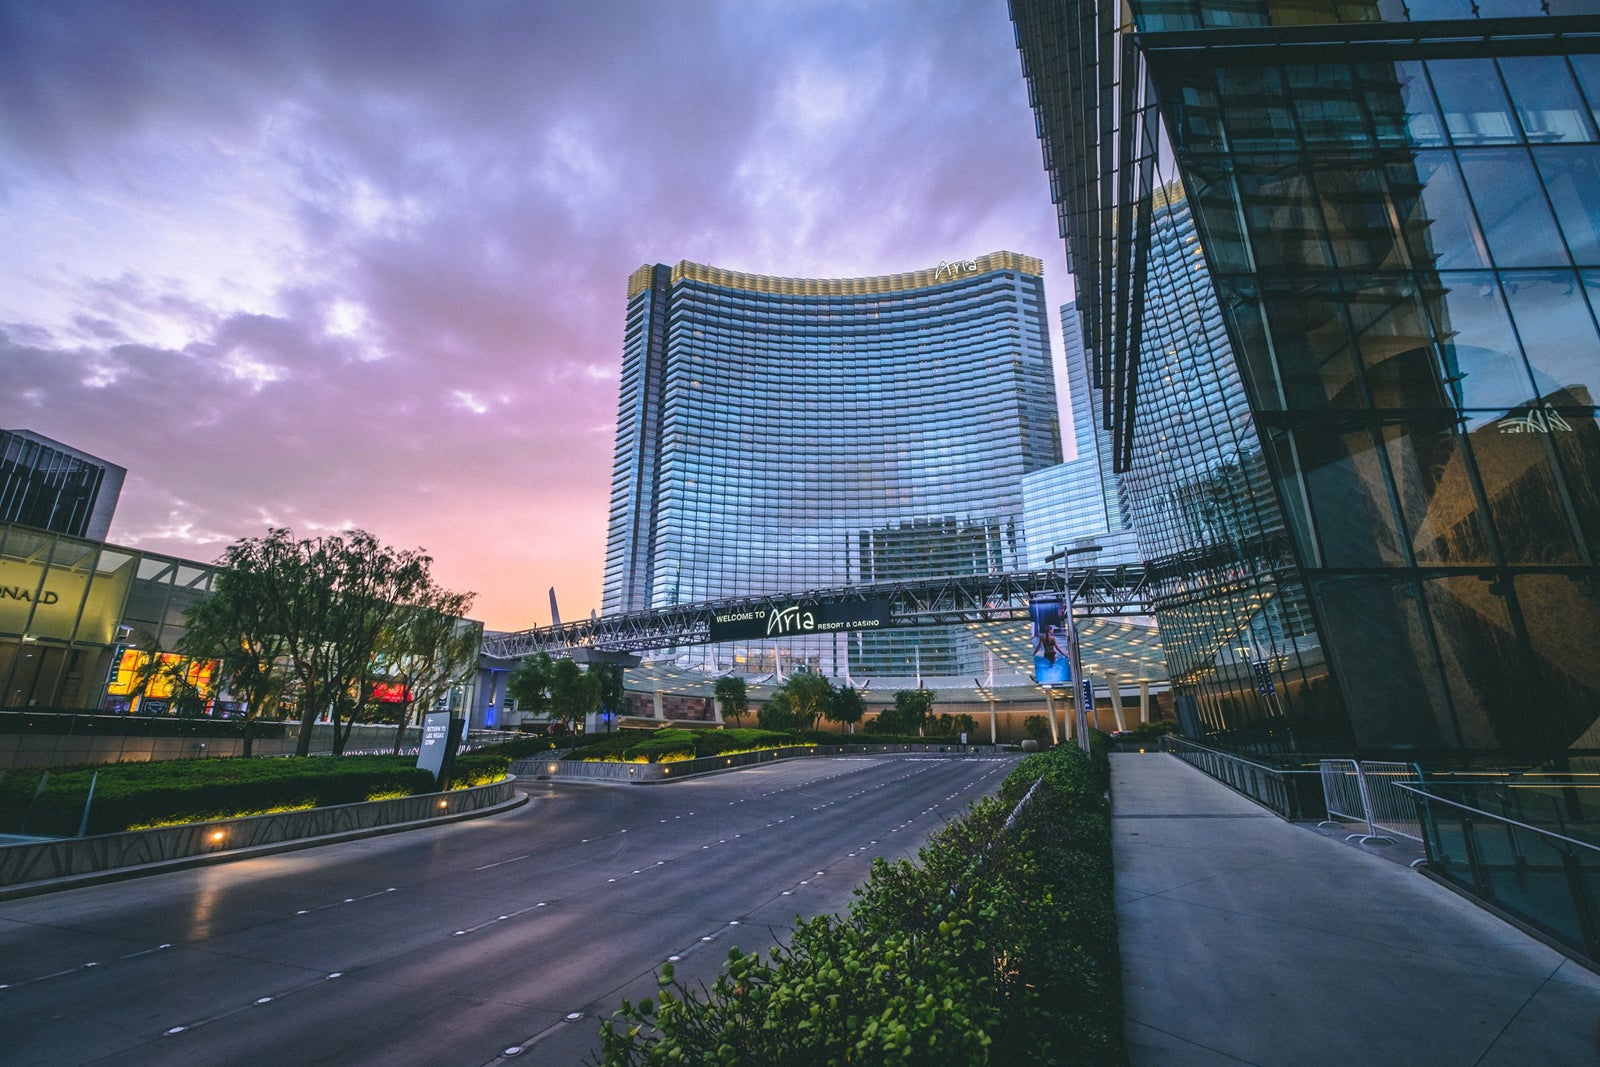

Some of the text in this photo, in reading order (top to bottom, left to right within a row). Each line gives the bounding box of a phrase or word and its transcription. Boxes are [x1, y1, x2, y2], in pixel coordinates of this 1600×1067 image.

[934, 258, 977, 280] Aria
[0, 586, 58, 605] NAD
[716, 606, 880, 635] WELCOME TO Aria RESORT & CASINO
